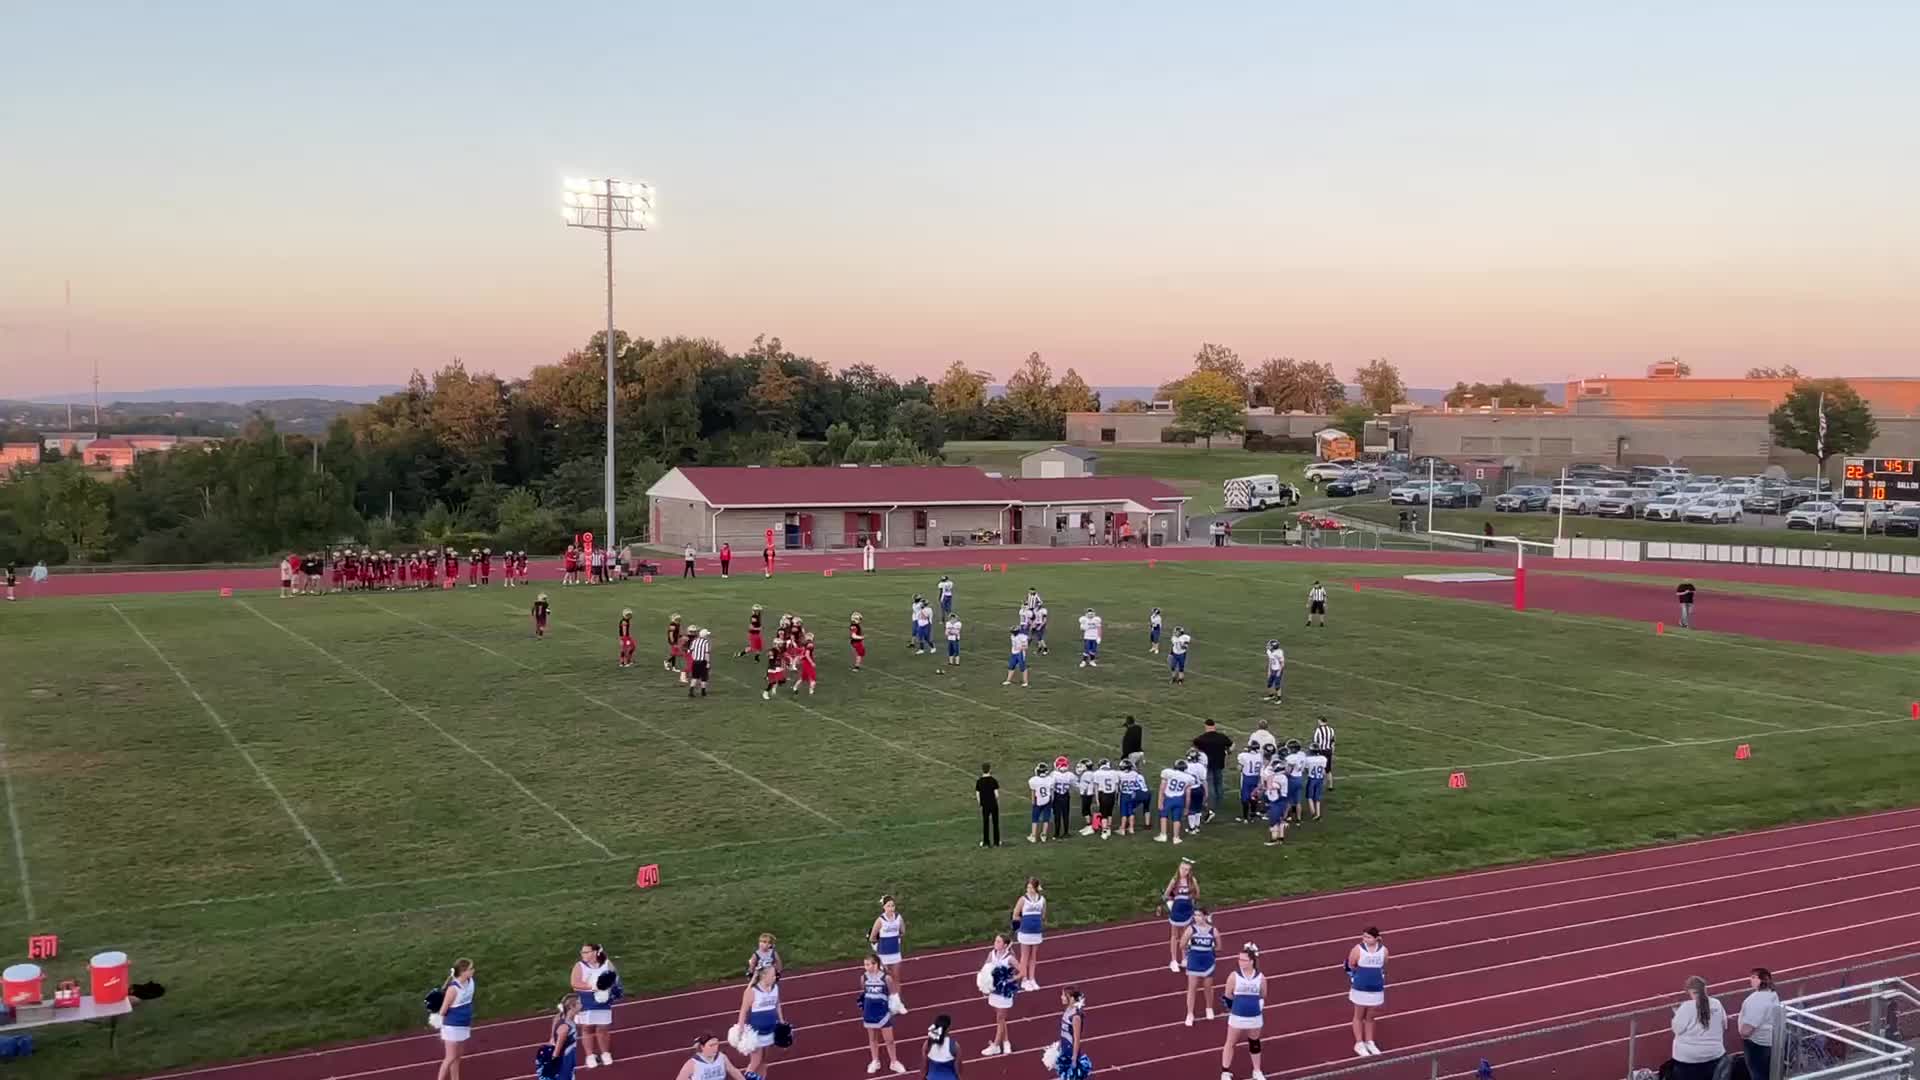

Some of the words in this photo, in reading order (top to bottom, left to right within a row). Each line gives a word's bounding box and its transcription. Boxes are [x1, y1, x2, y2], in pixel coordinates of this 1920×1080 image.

[1847, 466, 1864, 478] 22
[1884, 460, 1911, 472] 4:51
[1872, 487, 1885, 500] 10
[1169, 779, 1185, 792] 99
[1454, 775, 1465, 787] 20
[644, 867, 658, 885] 40
[31, 939, 54, 958] 50
